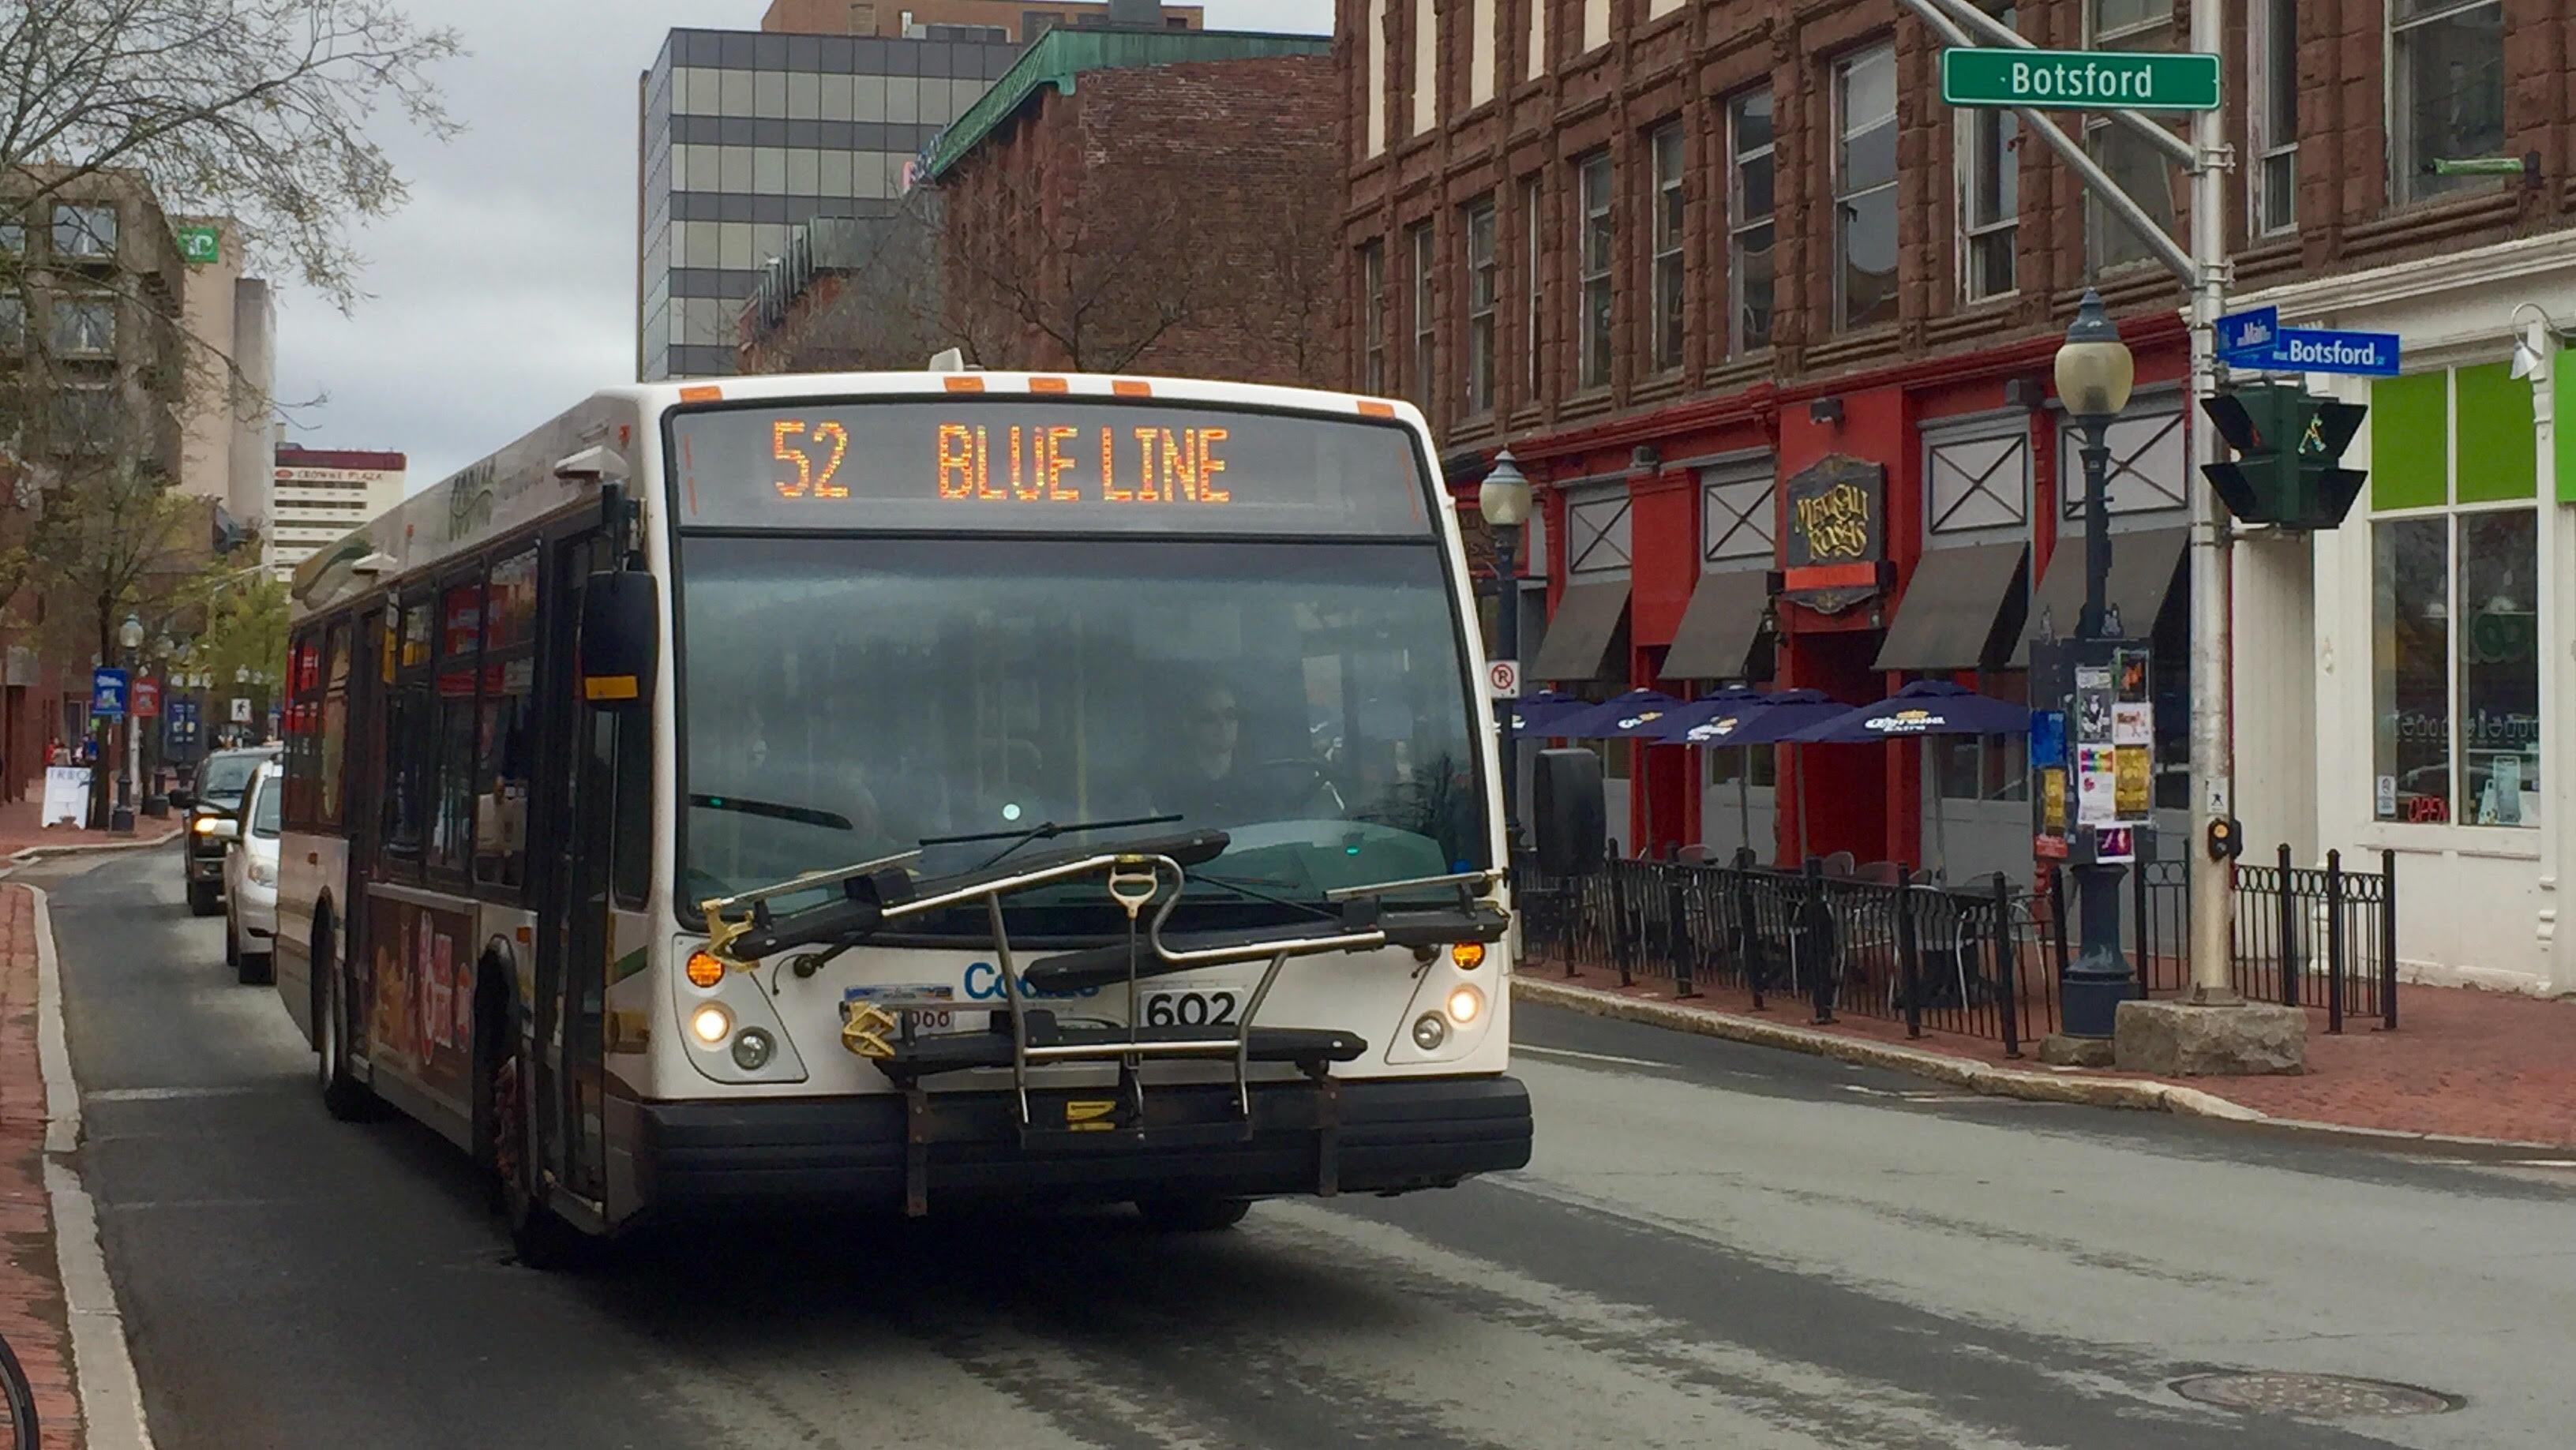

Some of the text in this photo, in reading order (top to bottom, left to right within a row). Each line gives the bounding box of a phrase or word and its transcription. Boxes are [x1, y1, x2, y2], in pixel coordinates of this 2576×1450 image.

[2012, 62, 2152, 97] Botsford
[2290, 339, 2375, 365] Botsford
[774, 422, 1230, 502] 52 BLUE LINE
[1147, 991, 1236, 1027] 602
